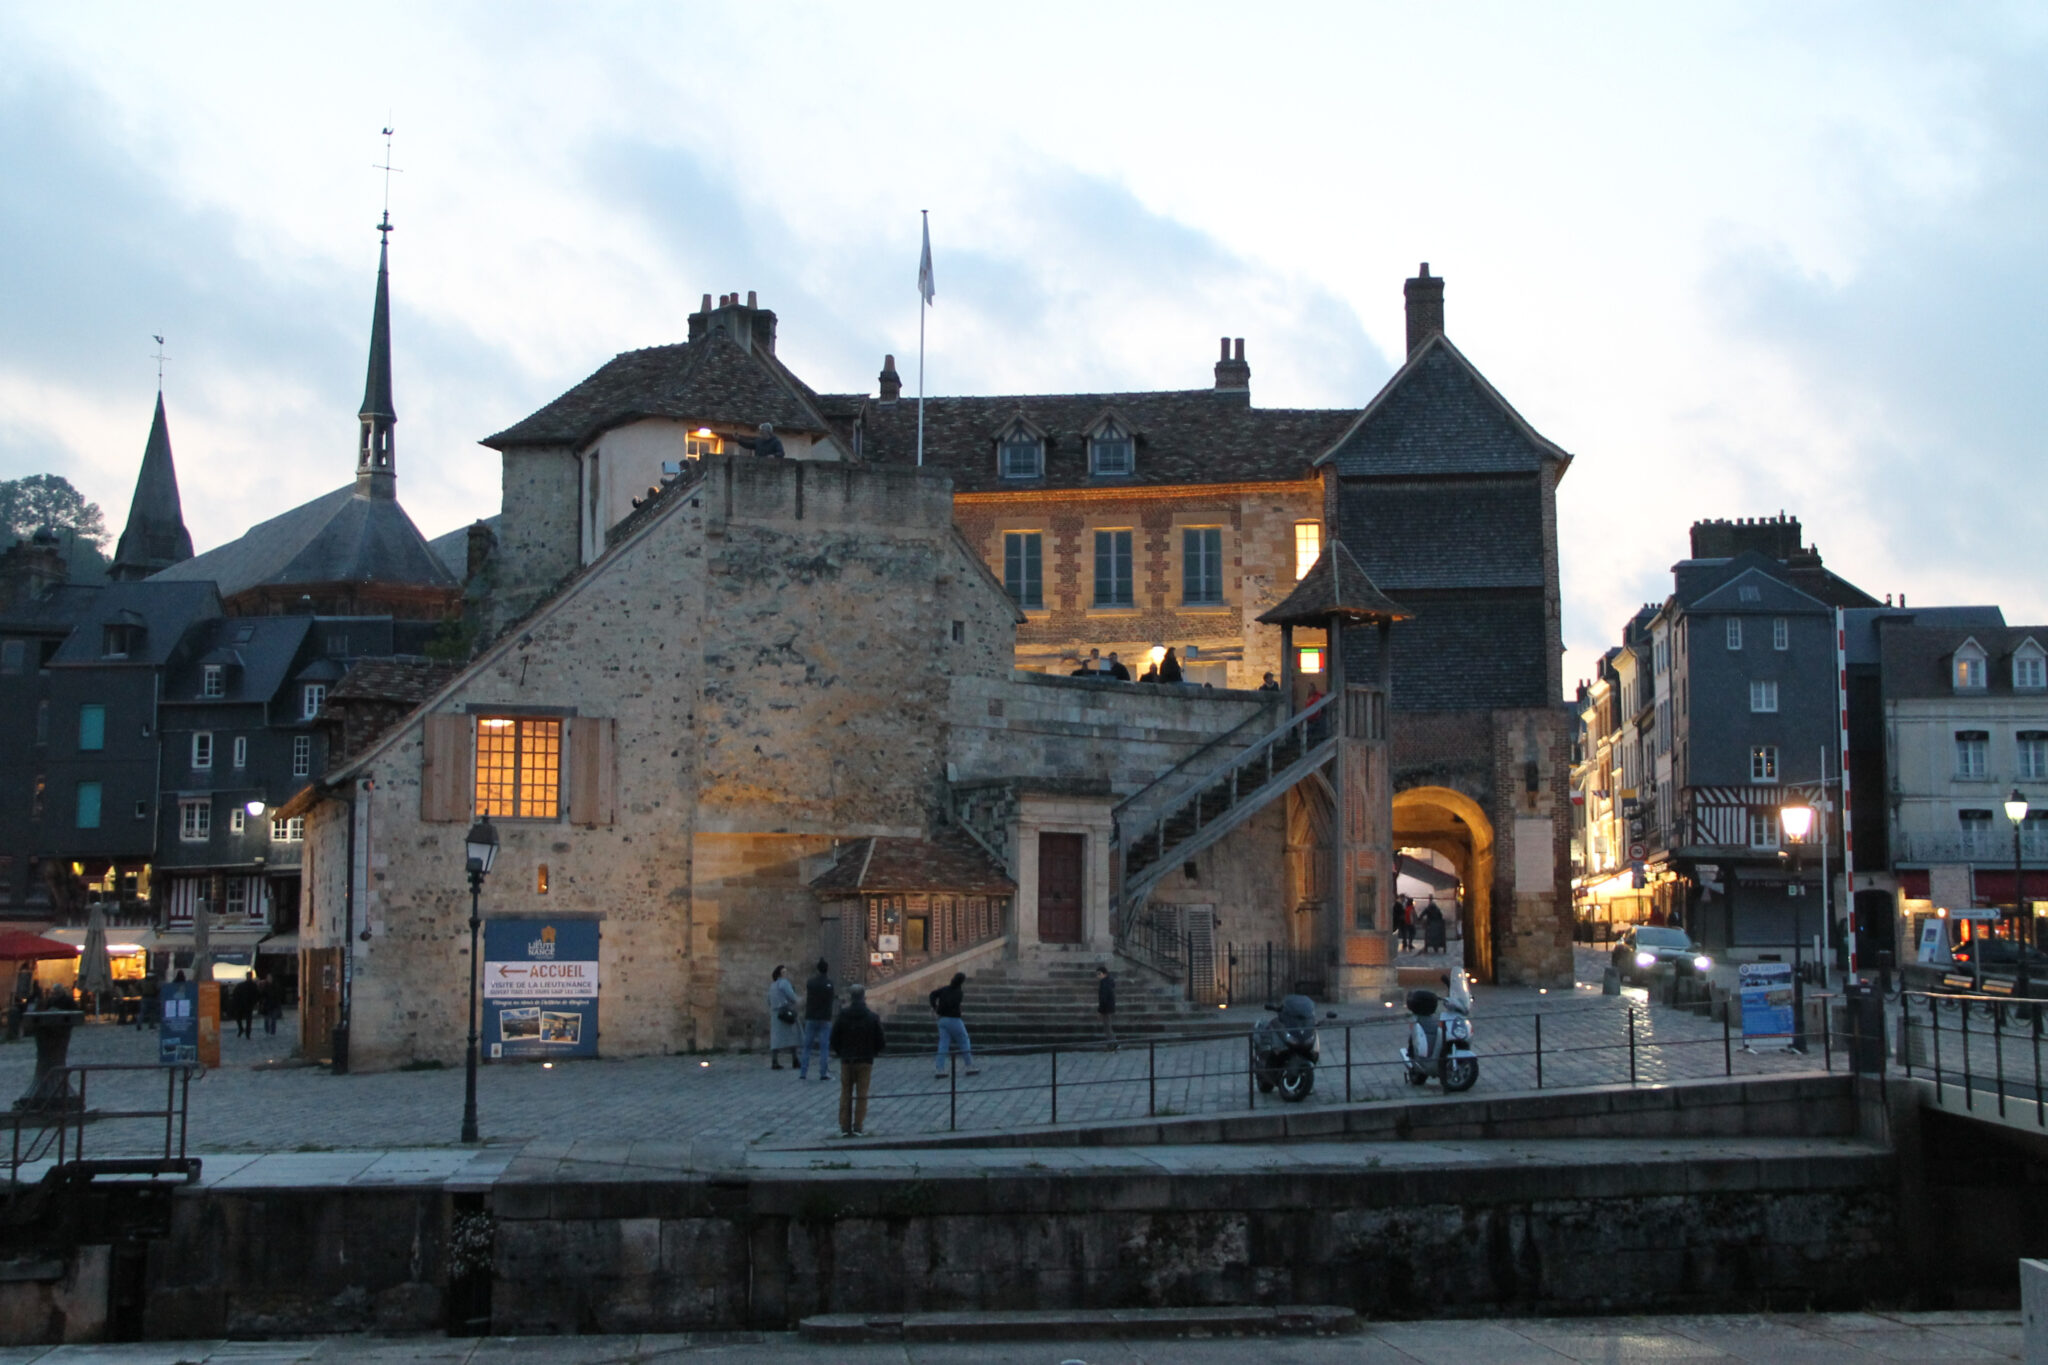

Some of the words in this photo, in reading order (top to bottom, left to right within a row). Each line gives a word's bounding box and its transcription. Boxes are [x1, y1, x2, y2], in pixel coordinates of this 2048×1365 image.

[529, 964, 585, 978] ACCUEIL
[491, 981, 513, 989] VISITE
[516, 981, 526, 989] DE
[528, 981, 538, 989] LA
